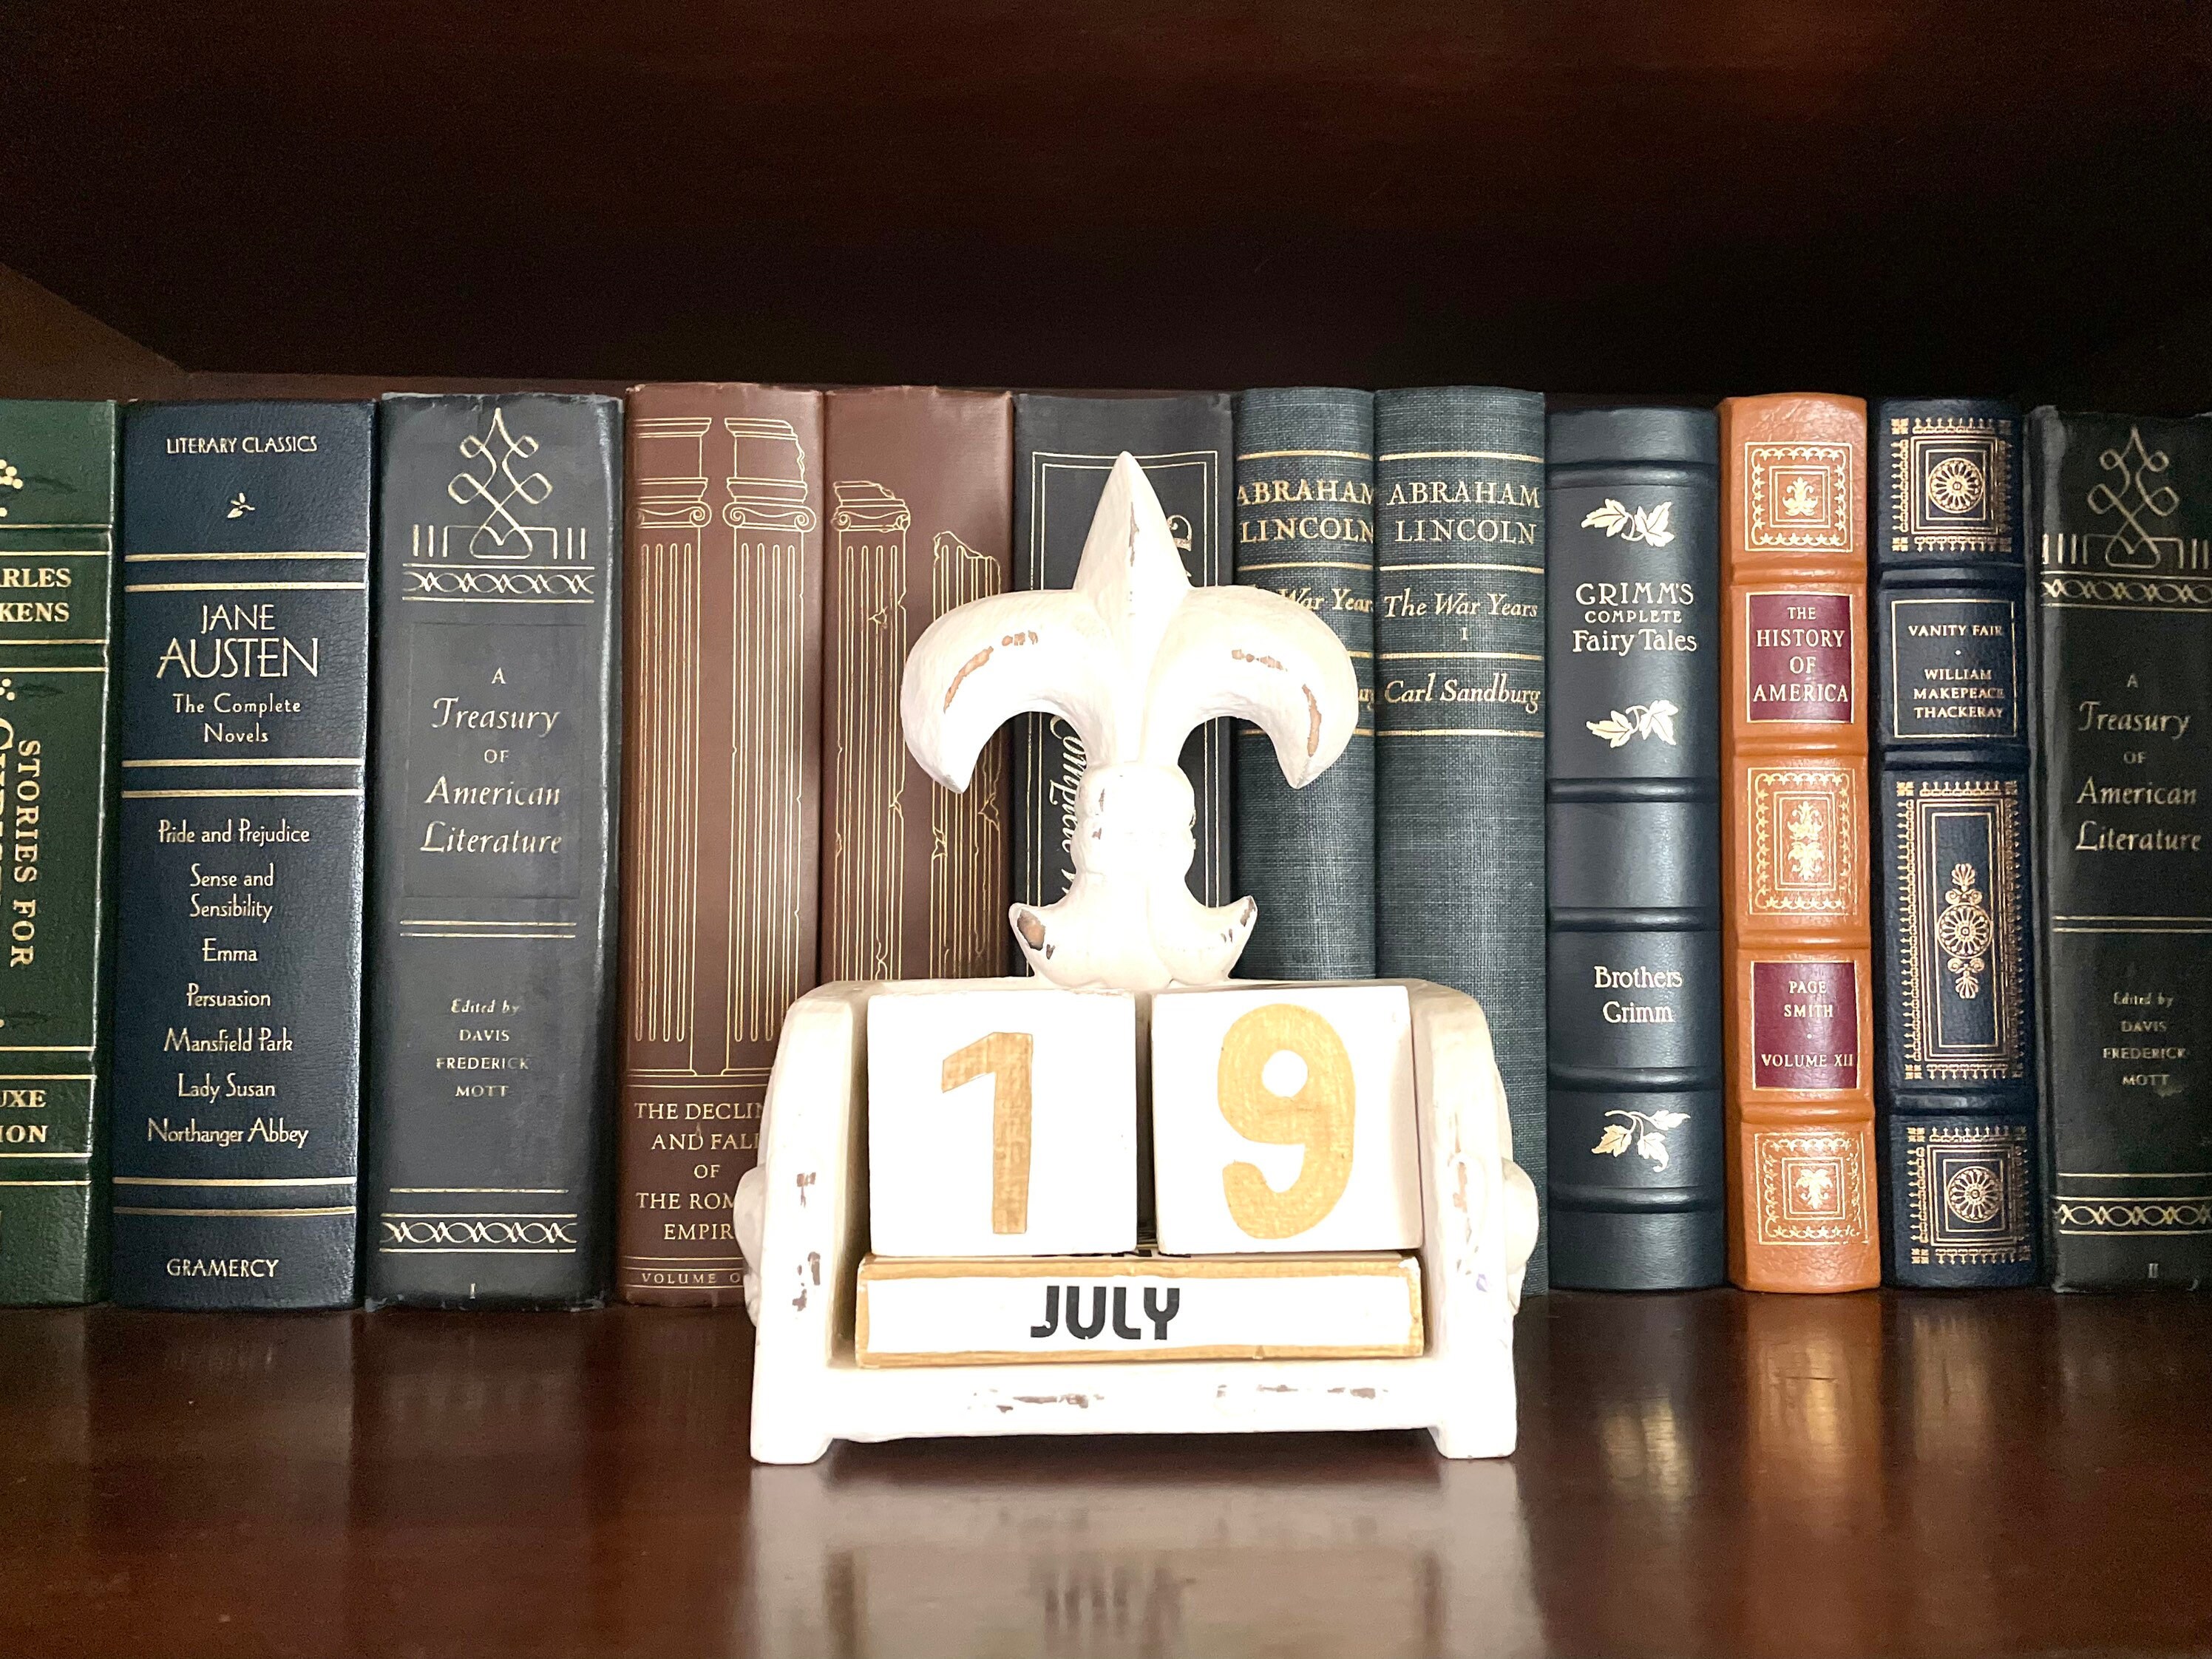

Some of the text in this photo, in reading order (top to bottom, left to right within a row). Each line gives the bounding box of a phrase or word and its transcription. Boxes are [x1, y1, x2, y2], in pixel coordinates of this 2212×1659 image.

[167, 436, 318, 454] LITERARY CLASSICS
[1386, 481, 1541, 509] ABRAHAM
[1239, 517, 1374, 543] LINCOLN
[1394, 519, 1537, 544] LINCOLN
[0, 568, 72, 588] RLES
[1331, 588, 1374, 613] Year
[1383, 588, 1538, 618] The War Years
[1575, 582, 1694, 607] GRIMM'S
[201, 604, 275, 634] JANE
[1584, 610, 1683, 624] COMPLETE
[1787, 606, 1816, 621] THE
[1756, 628, 1845, 648] HISTORY
[1908, 625, 2003, 637] VANITY FAIR
[1572, 628, 1697, 657] Fairy Tales
[156, 637, 318, 679] AUSTEN
[1789, 656, 1816, 674] OF
[491, 667, 506, 684] A
[1924, 668, 1992, 681] WILLIAM
[2126, 674, 2139, 688] A
[1384, 672, 1433, 703] Carl
[1439, 672, 1541, 714] Sandburg
[1753, 684, 1848, 703] AMERICA
[1913, 688, 2005, 699] MAKEPEACE
[173, 693, 301, 718] The Complete
[1913, 706, 2003, 719] THACKERAY
[431, 696, 560, 738] Treasury
[2078, 701, 2192, 740] Treasury
[204, 722, 268, 744] Novels
[484, 749, 510, 764] OF
[2123, 750, 2146, 764] OF
[424, 776, 560, 805] American
[2076, 776, 2197, 805] American
[158, 818, 311, 847] Pride and Prejudice
[420, 820, 562, 854] Literature
[2075, 820, 2202, 852] Literature
[10, 740, 41, 968] STORIES FOR
[190, 862, 274, 886] Sense and
[190, 893, 273, 923] Sensibility
[202, 938, 257, 962] Emma
[1593, 966, 1683, 989] Brothers
[1788, 980, 1827, 994] PAGE
[186, 983, 271, 1007] Persuasion
[451, 998, 495, 1013] Edited
[1602, 1000, 1675, 1024] Grimm
[1784, 1004, 1833, 1018] SMITH
[459, 1030, 509, 1042] DAVIS
[2120, 1021, 2167, 1032] DAVIS
[163, 1027, 294, 1052] Mansfield Park
[436, 1057, 529, 1070] FREDERICK
[1761, 1054, 1853, 1068] VOLUME XII
[2103, 1048, 2186, 1059] FREDERICK
[178, 1073, 276, 1103] Lady Susan
[2122, 1074, 2170, 1085] MOTT
[455, 1085, 509, 1097] MOTT
[634, 1103, 679, 1120] THE
[148, 1117, 308, 1148] Northanger Abbey
[651, 1133, 705, 1150] AND
[693, 1164, 721, 1179] OF
[635, 1192, 681, 1210] THE
[664, 1224, 735, 1241] EMPIR
[167, 1259, 279, 1278] GRAMERCY
[642, 1272, 717, 1284] VOLUME
[1030, 1285, 1181, 1340] JULY
